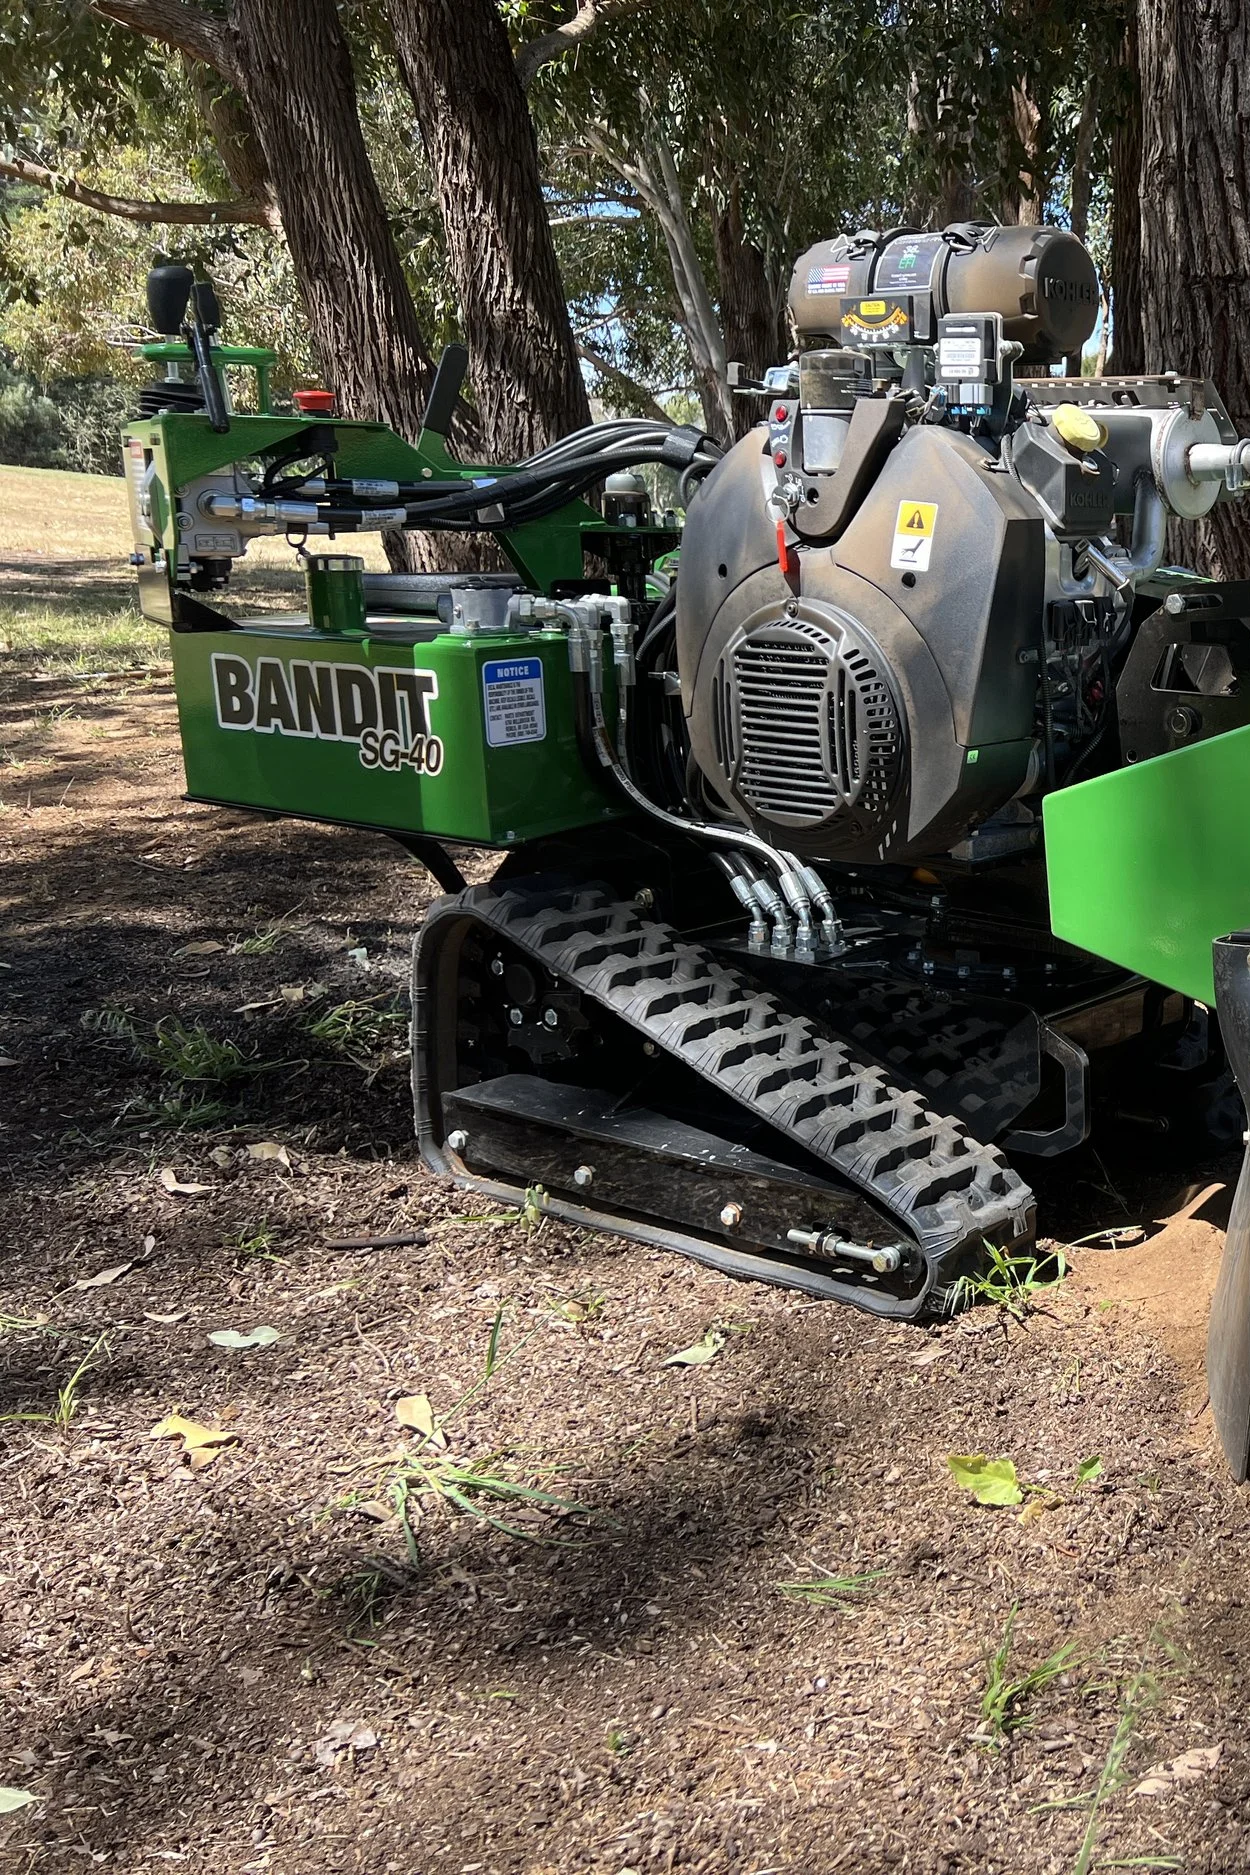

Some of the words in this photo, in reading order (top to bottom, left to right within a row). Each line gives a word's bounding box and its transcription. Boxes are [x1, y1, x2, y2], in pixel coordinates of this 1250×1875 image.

[898, 255, 917, 269] EFI
[1044, 277, 1098, 305] KOHLER
[1068, 491, 1109, 508] KOHLER
[497, 665, 530, 678] NOTICE
[212, 654, 437, 741] BANDIT
[360, 729, 443, 775] SG-40
